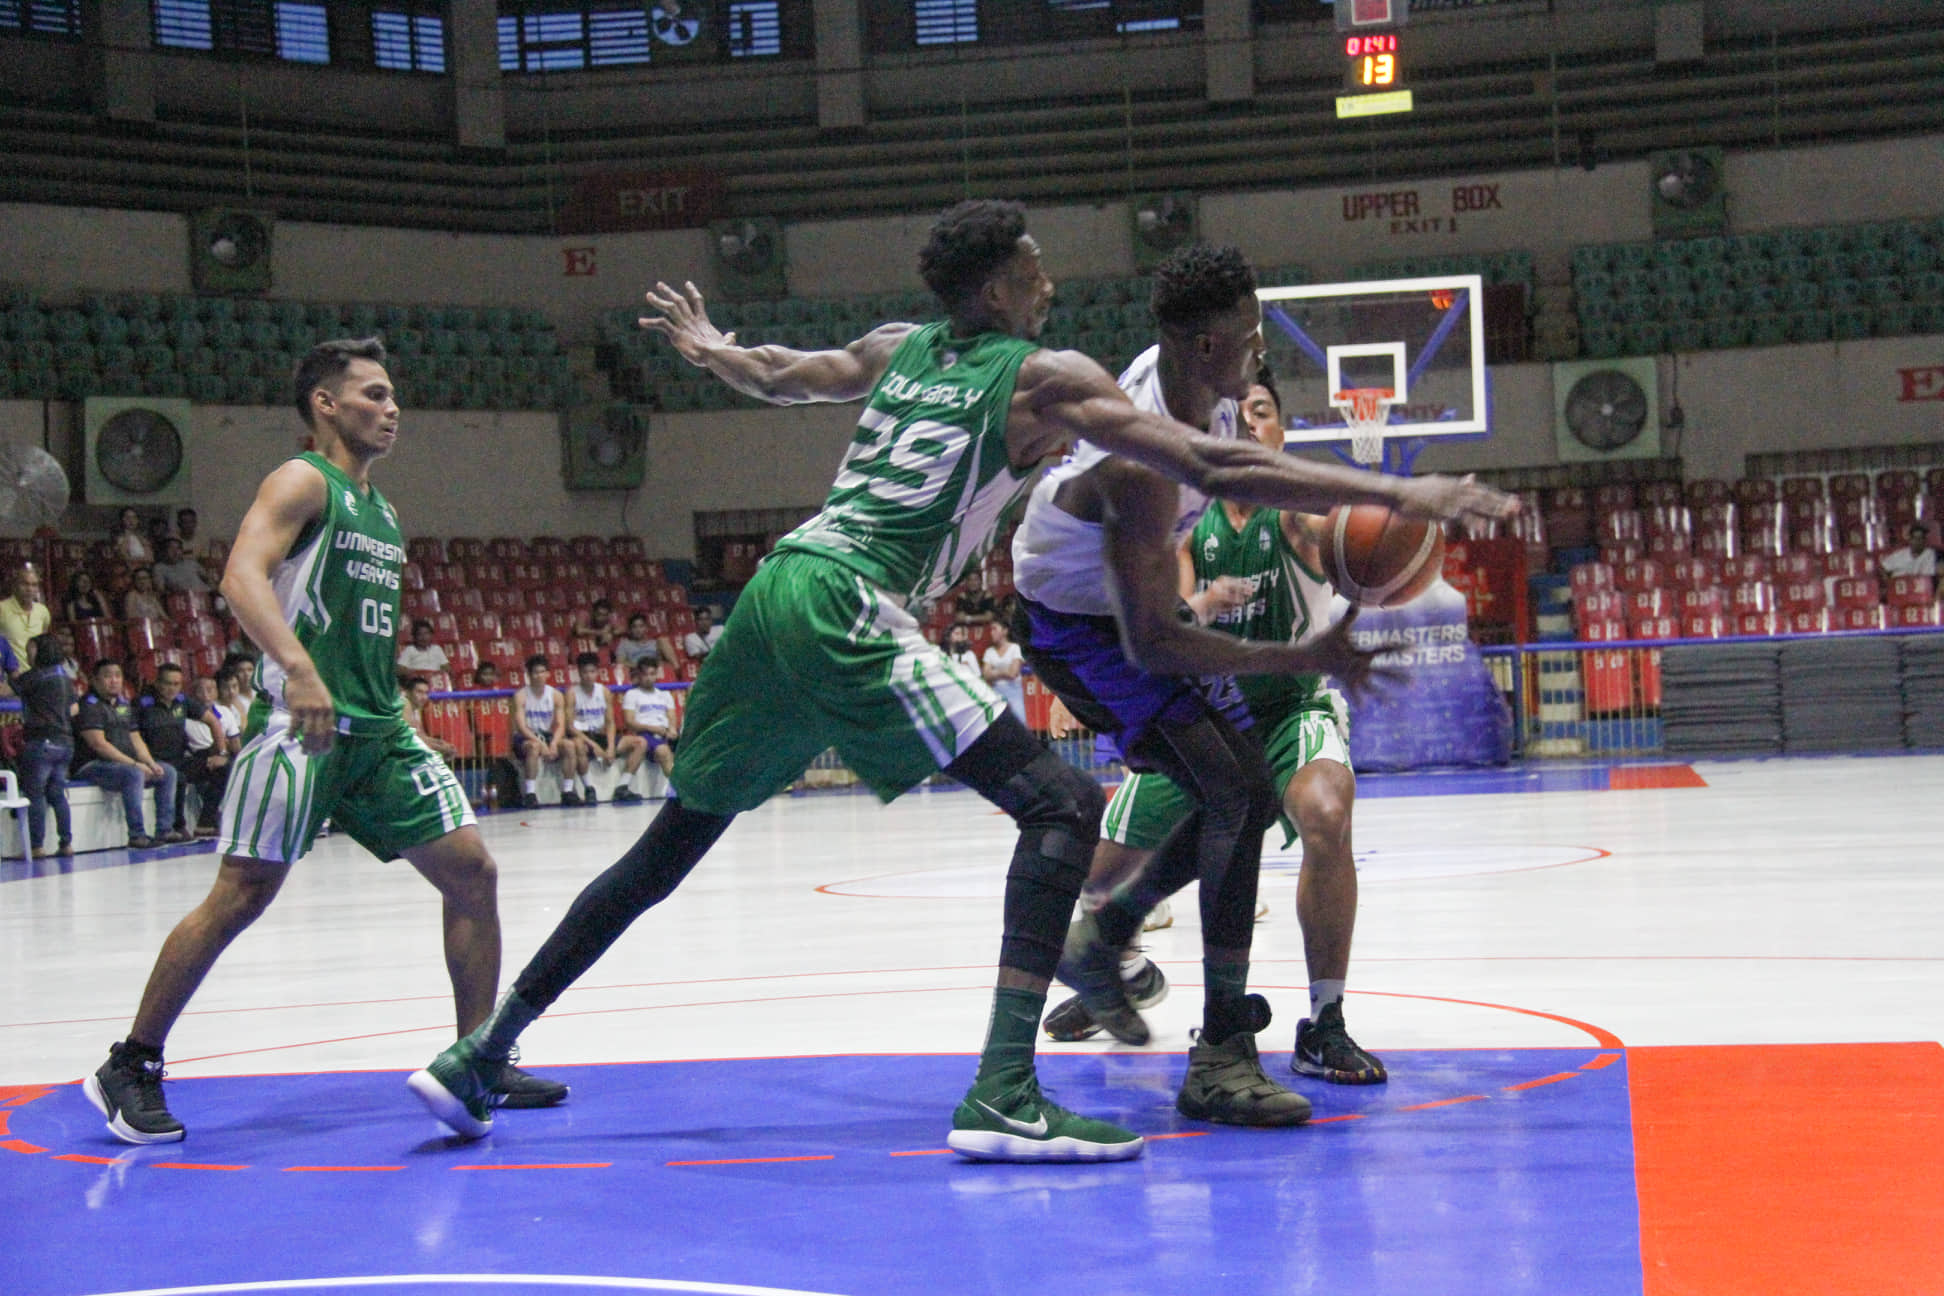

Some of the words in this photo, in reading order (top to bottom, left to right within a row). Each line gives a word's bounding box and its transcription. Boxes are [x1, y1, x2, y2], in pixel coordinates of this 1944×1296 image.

[1363, 54, 1395, 85] 13
[618, 186, 687, 217] EXIT
[1342, 190, 1420, 221] UPPER
[1453, 184, 1502, 212] BOX
[1390, 217, 1441, 234] EXIT
[562, 248, 596, 276] E
[361, 598, 393, 638] 05
[1349, 623, 1467, 648] EBMASTERS
